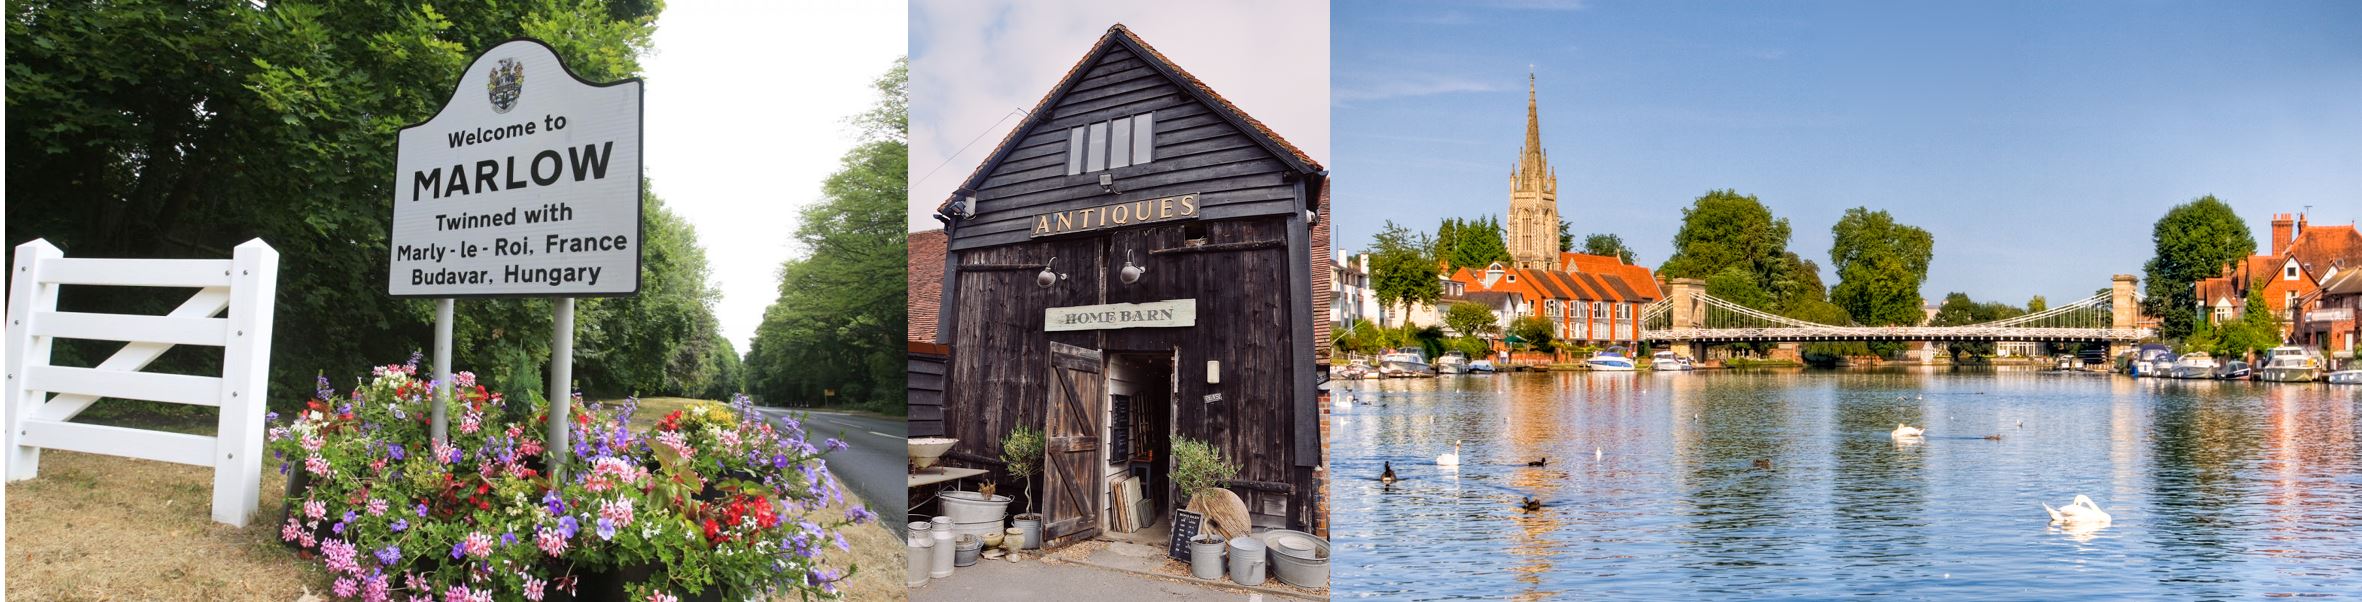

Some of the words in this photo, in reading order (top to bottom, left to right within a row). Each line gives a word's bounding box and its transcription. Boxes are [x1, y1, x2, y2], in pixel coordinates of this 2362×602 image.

[448, 121, 537, 148] Welcome
[545, 114, 567, 131] to
[413, 141, 614, 201] MARLOW
[436, 207, 516, 231] Twinned
[524, 203, 573, 224] with
[1034, 195, 1194, 235] ANTIQUES
[546, 234, 628, 254] France
[411, 268, 493, 286] Budavar,
[504, 265, 602, 286] Hungary
[1065, 311, 1116, 325] HOME
[1120, 308, 1174, 323] BARN
